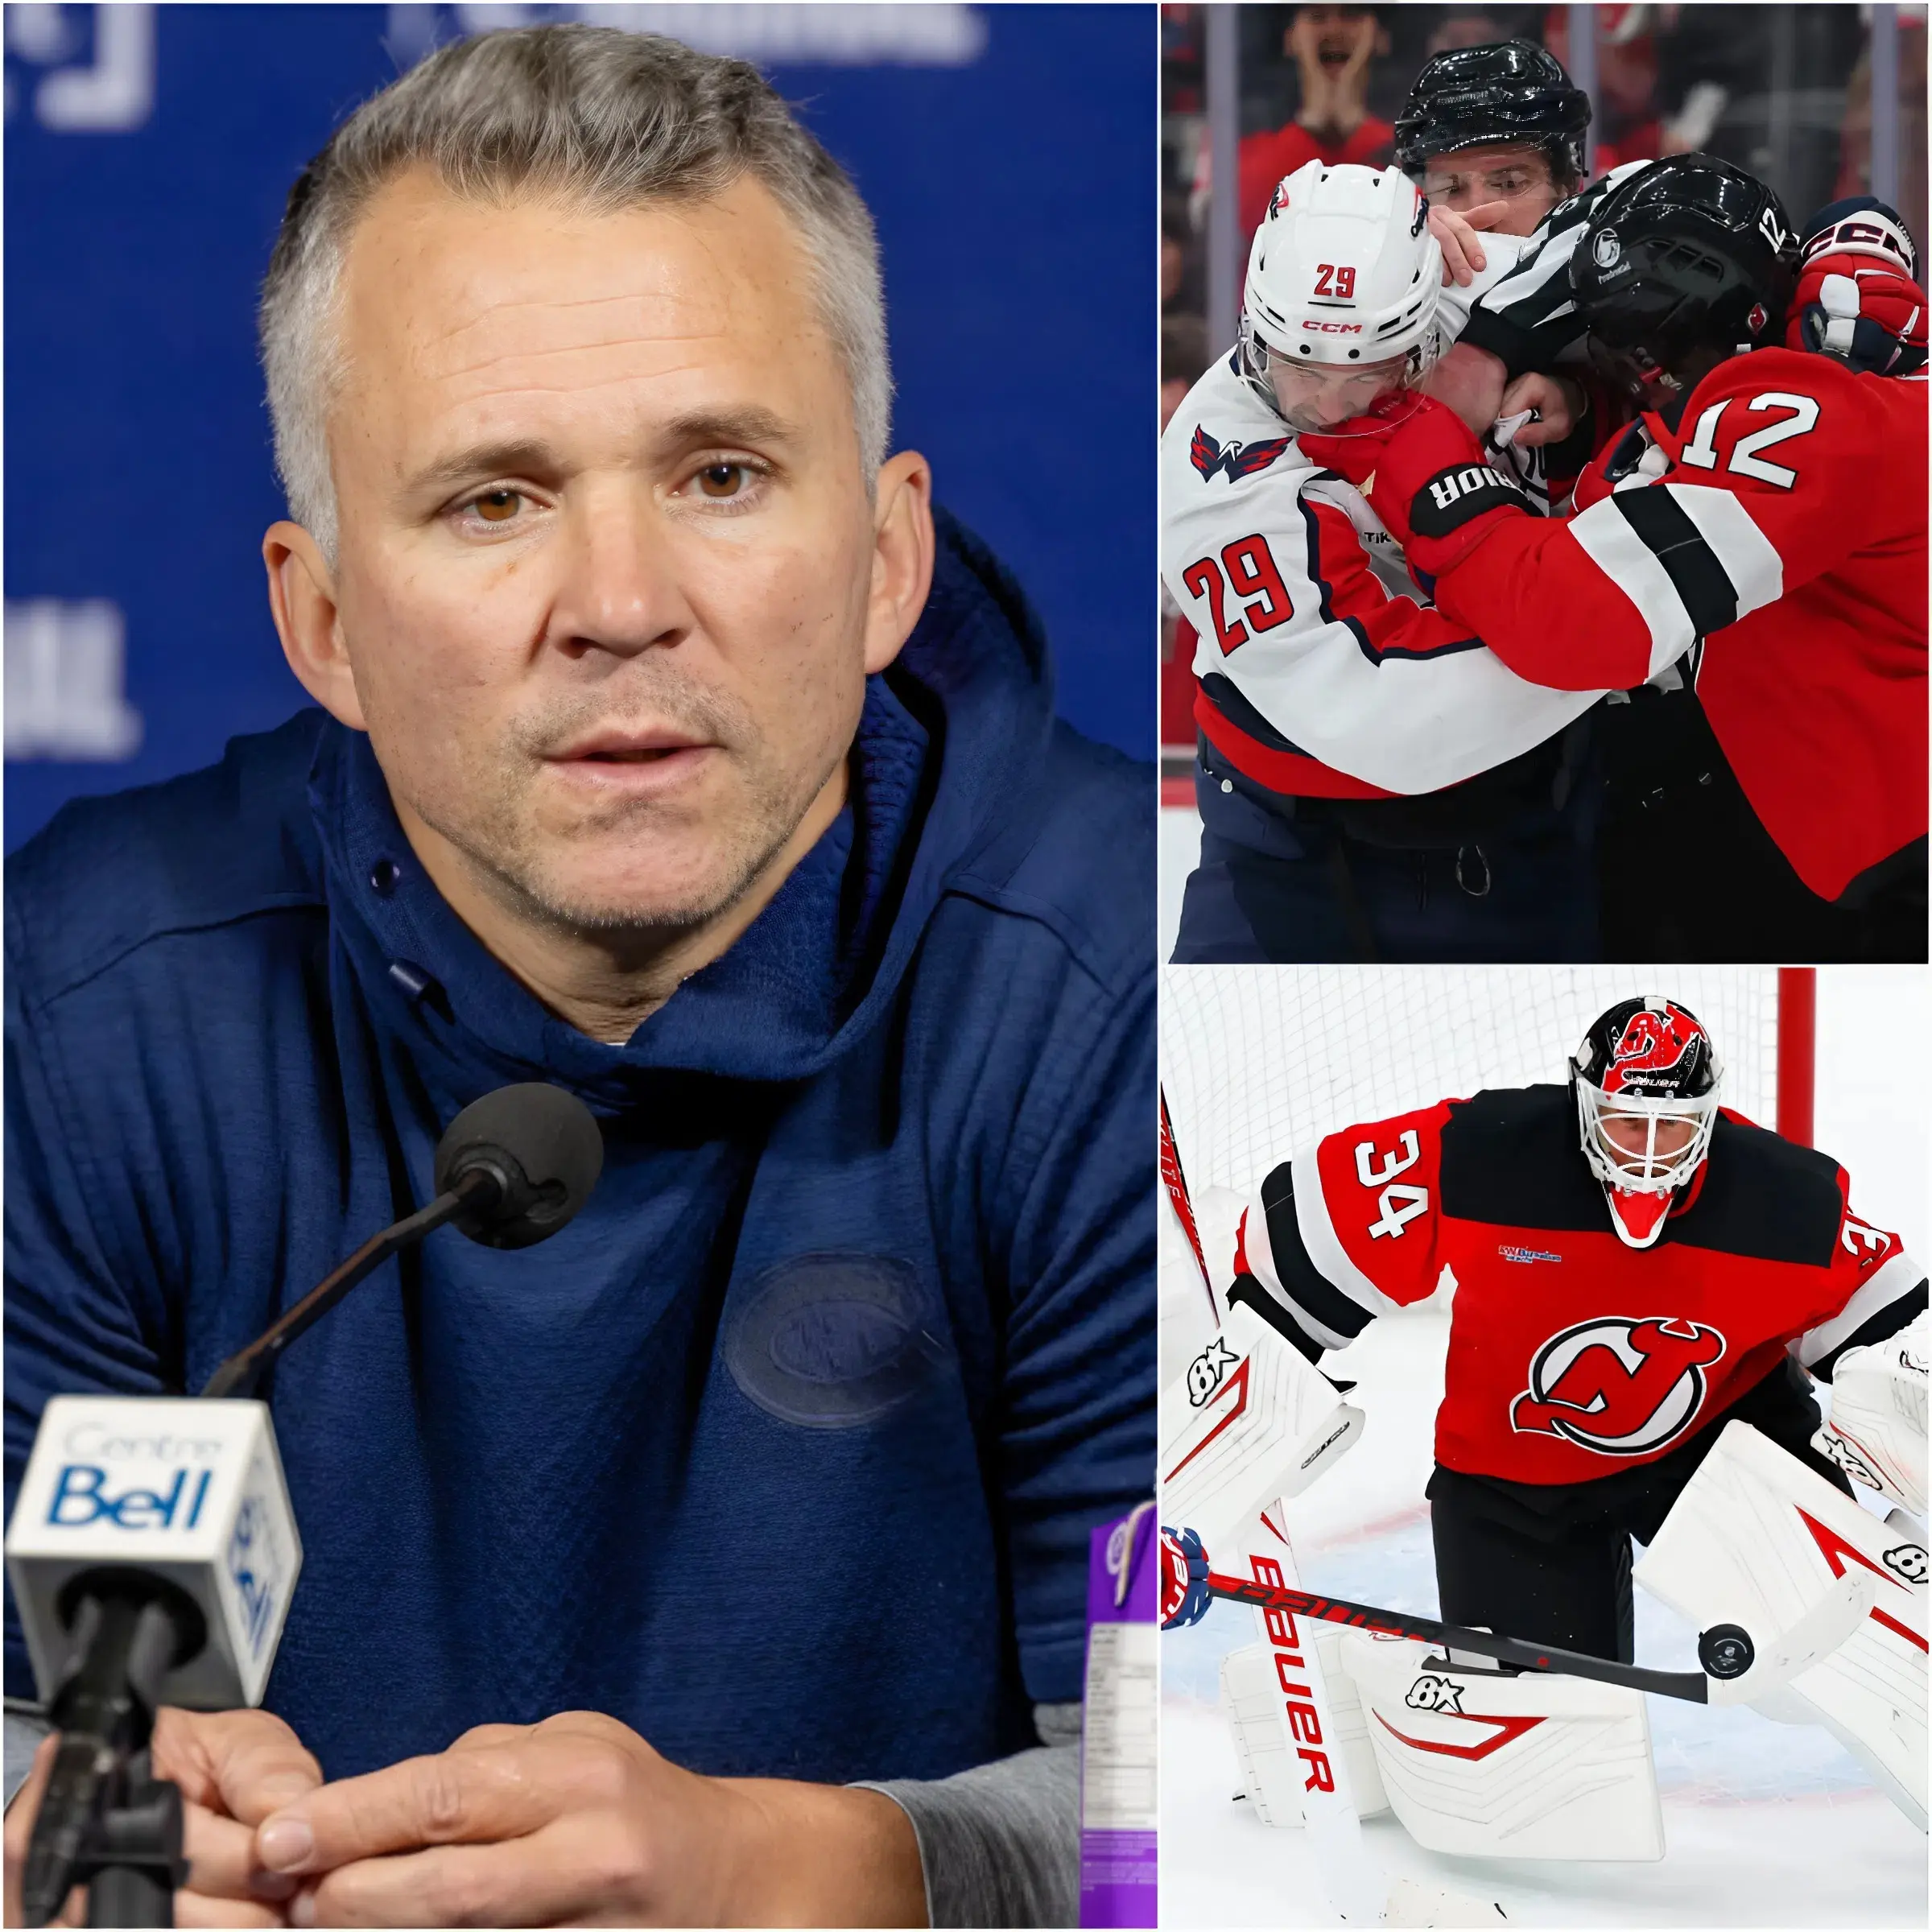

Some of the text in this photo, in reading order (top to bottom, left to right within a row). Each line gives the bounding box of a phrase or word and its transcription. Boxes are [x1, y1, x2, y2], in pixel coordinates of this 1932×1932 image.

[1759, 208, 1786, 254] 12
[1314, 263, 1356, 299] 29
[1302, 320, 1362, 334] CCM
[1681, 391, 1821, 489] 12
[1183, 533, 1294, 658] 29
[1355, 1129, 1429, 1240] 34
[1841, 1210, 1891, 1267] 3
[64, 1422, 222, 1459] Centre
[46, 1464, 213, 1529] Bell
